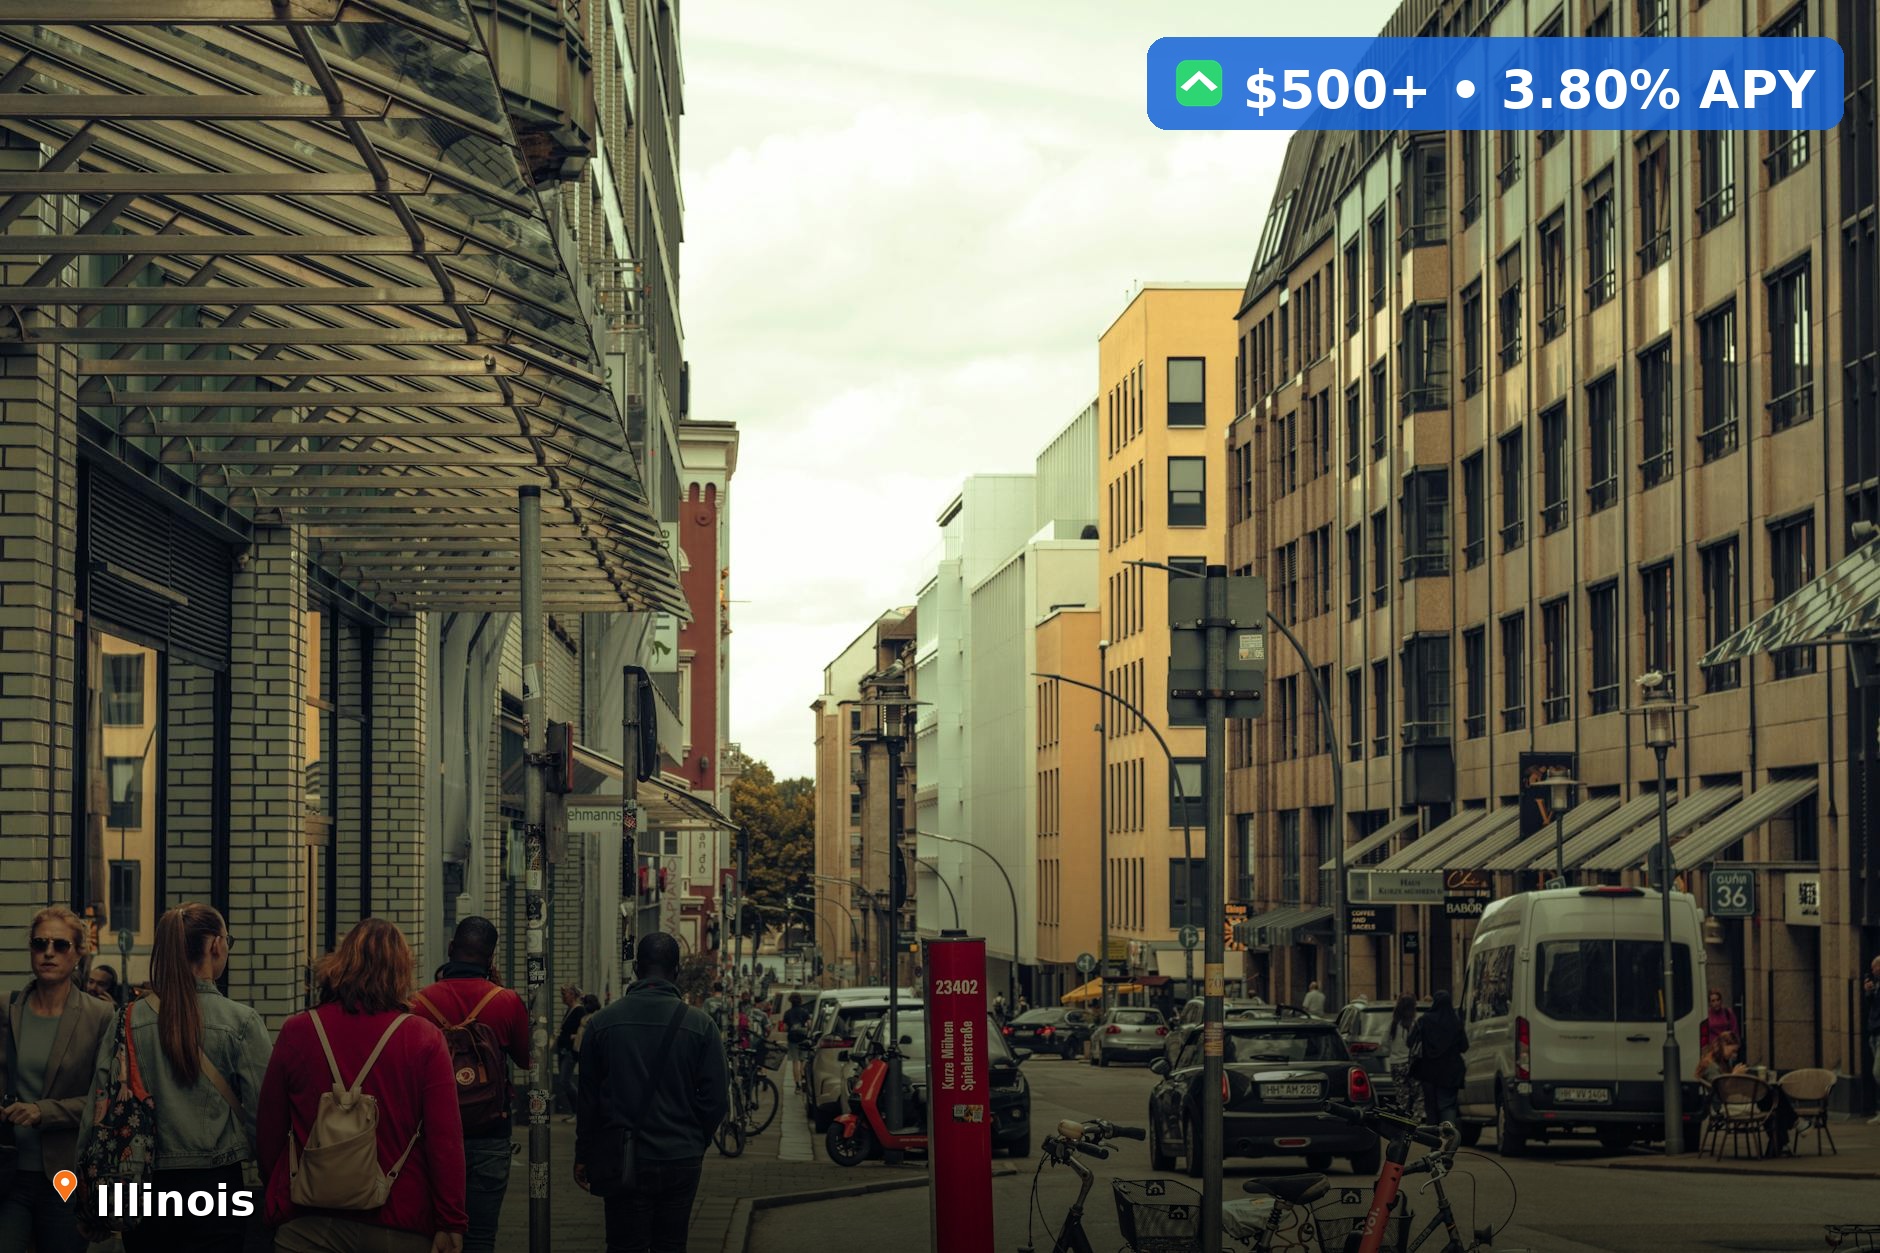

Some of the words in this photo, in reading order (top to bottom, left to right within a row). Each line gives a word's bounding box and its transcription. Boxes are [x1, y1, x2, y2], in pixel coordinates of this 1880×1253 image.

[567, 807, 622, 822] ehmanns
[664, 857, 678, 936] VAPIANO
[1446, 902, 1483, 914] BABOR
[1716, 885, 1748, 908] 36
[935, 979, 979, 995] 23402
[940, 1020, 955, 1060] Mühren
[960, 1020, 975, 1092] Spitalerstraße
[941, 1062, 955, 1090] Kurze
[1300, 1085, 1319, 1095] 282
